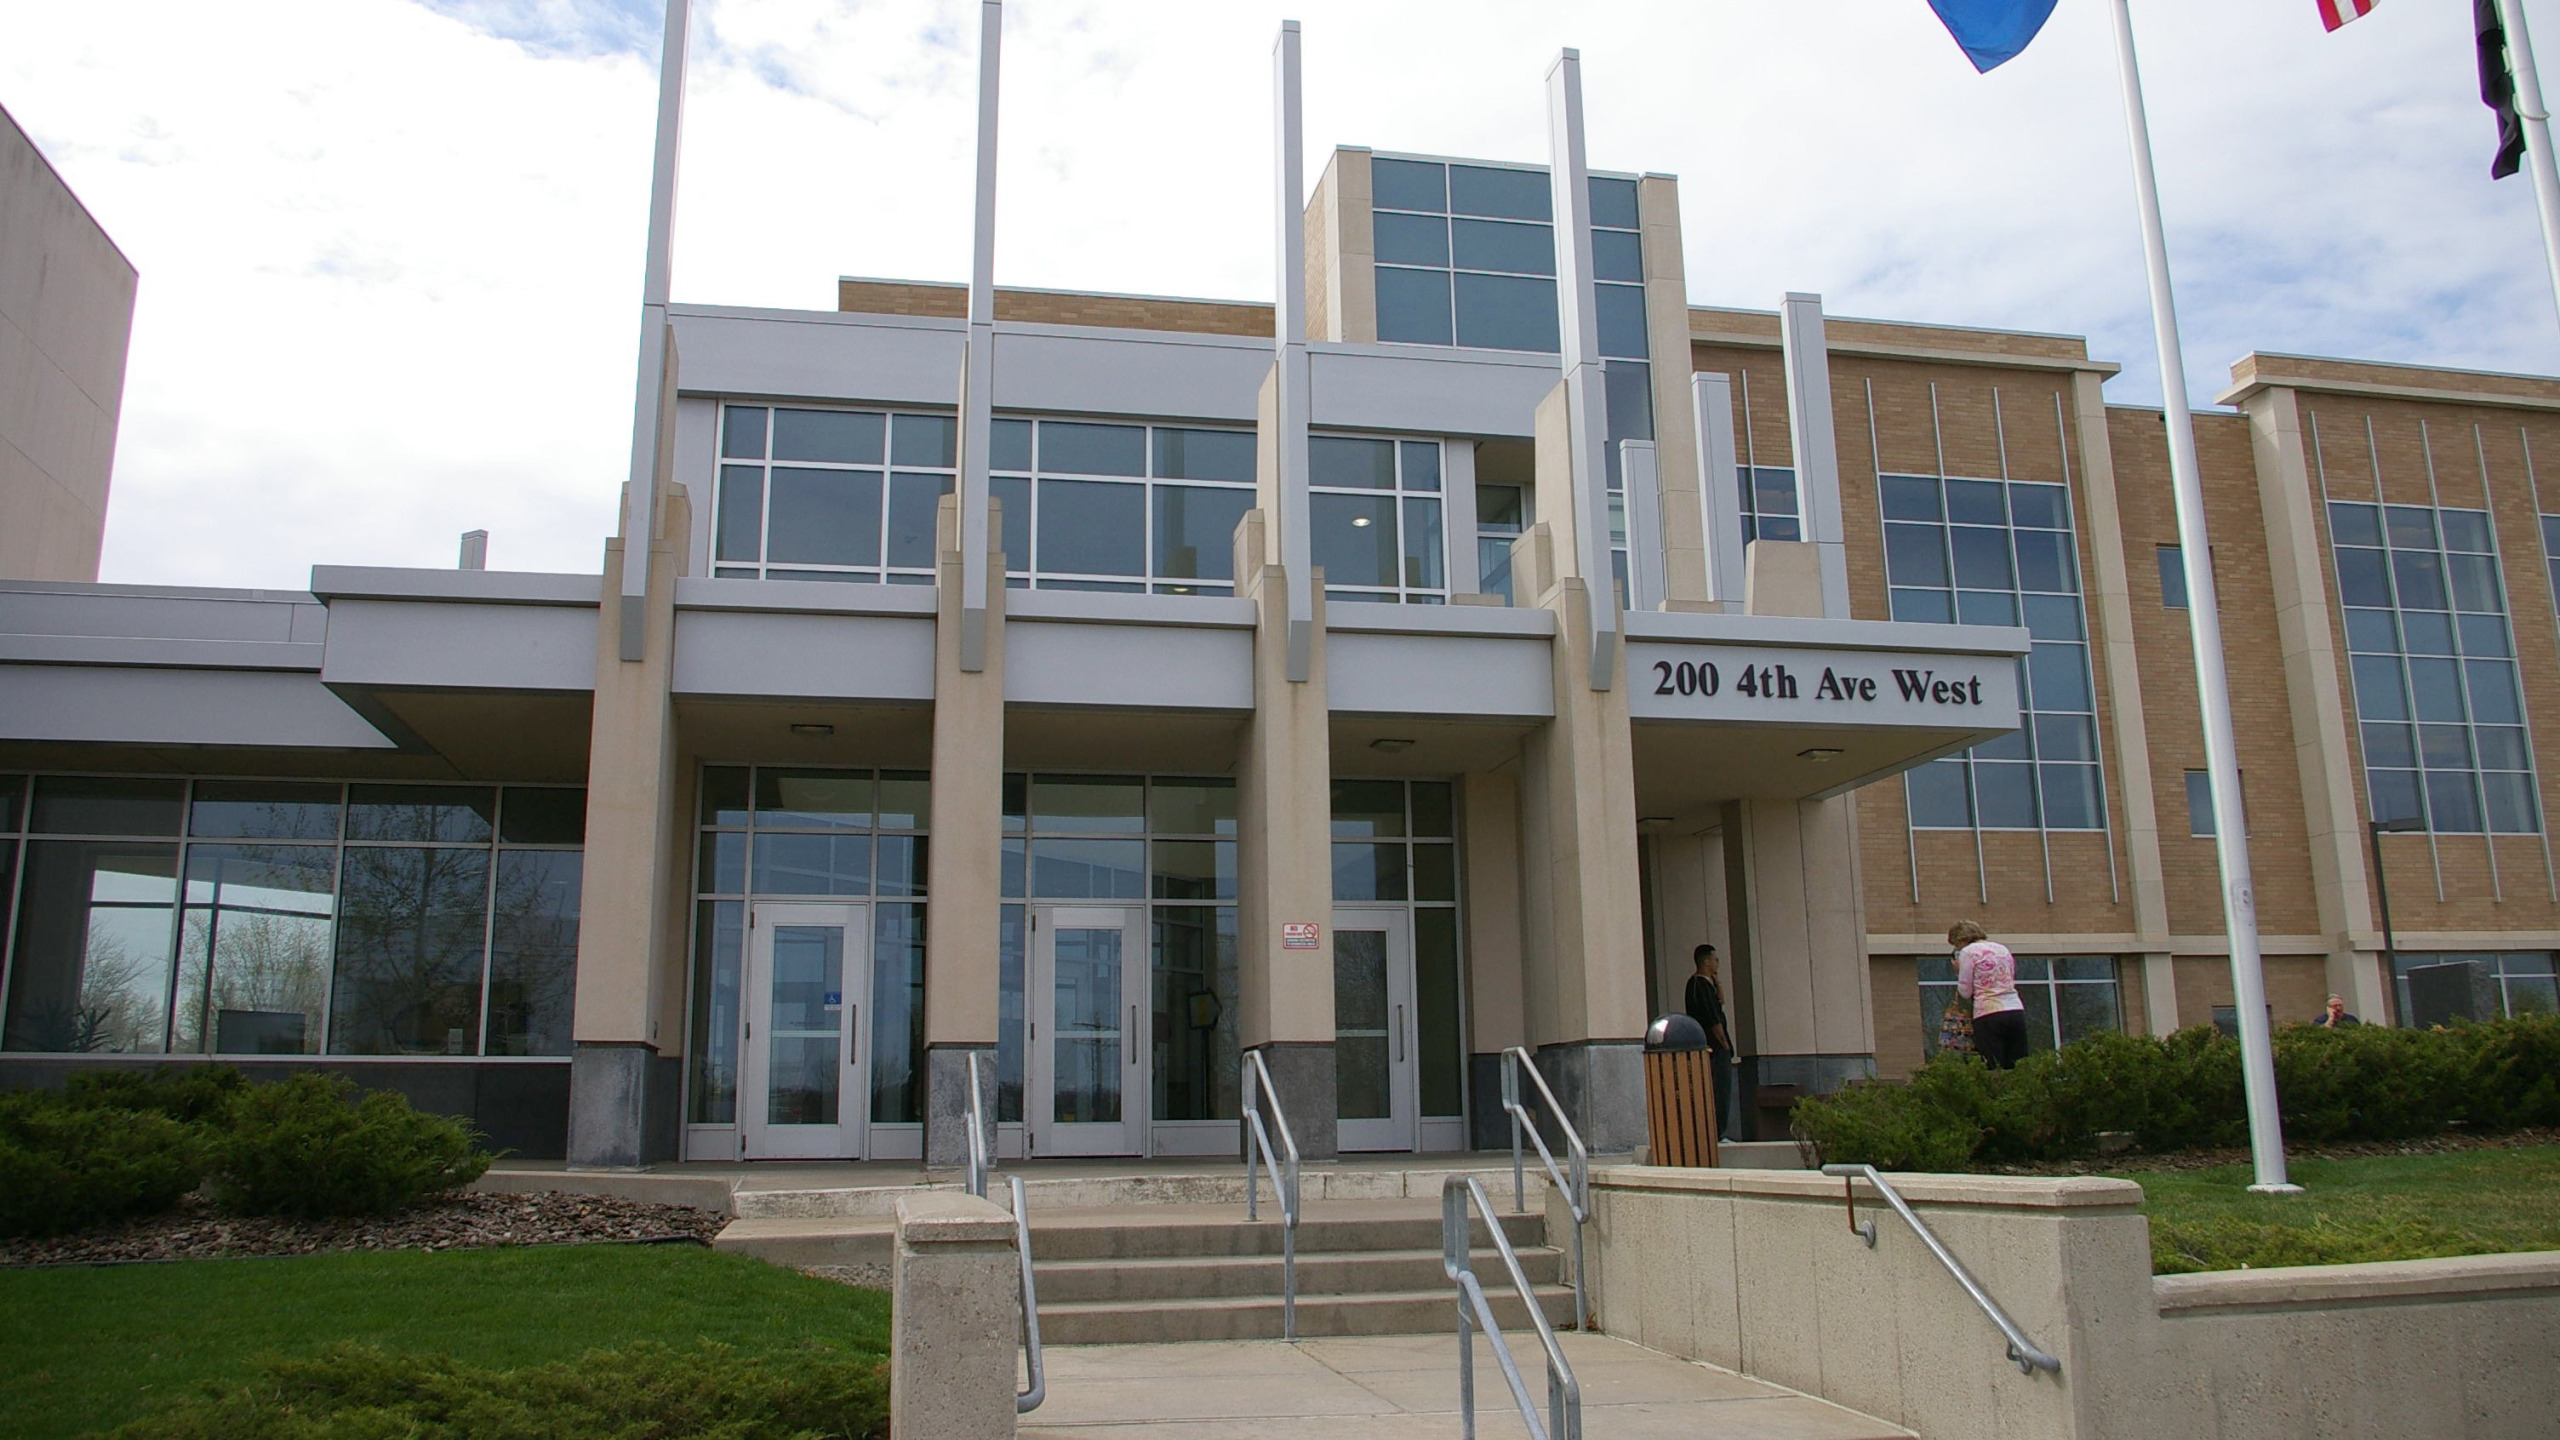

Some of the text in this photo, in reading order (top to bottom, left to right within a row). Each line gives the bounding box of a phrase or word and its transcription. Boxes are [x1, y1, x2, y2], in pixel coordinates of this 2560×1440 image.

[1653, 660, 1983, 706] 200 4th Ave West
